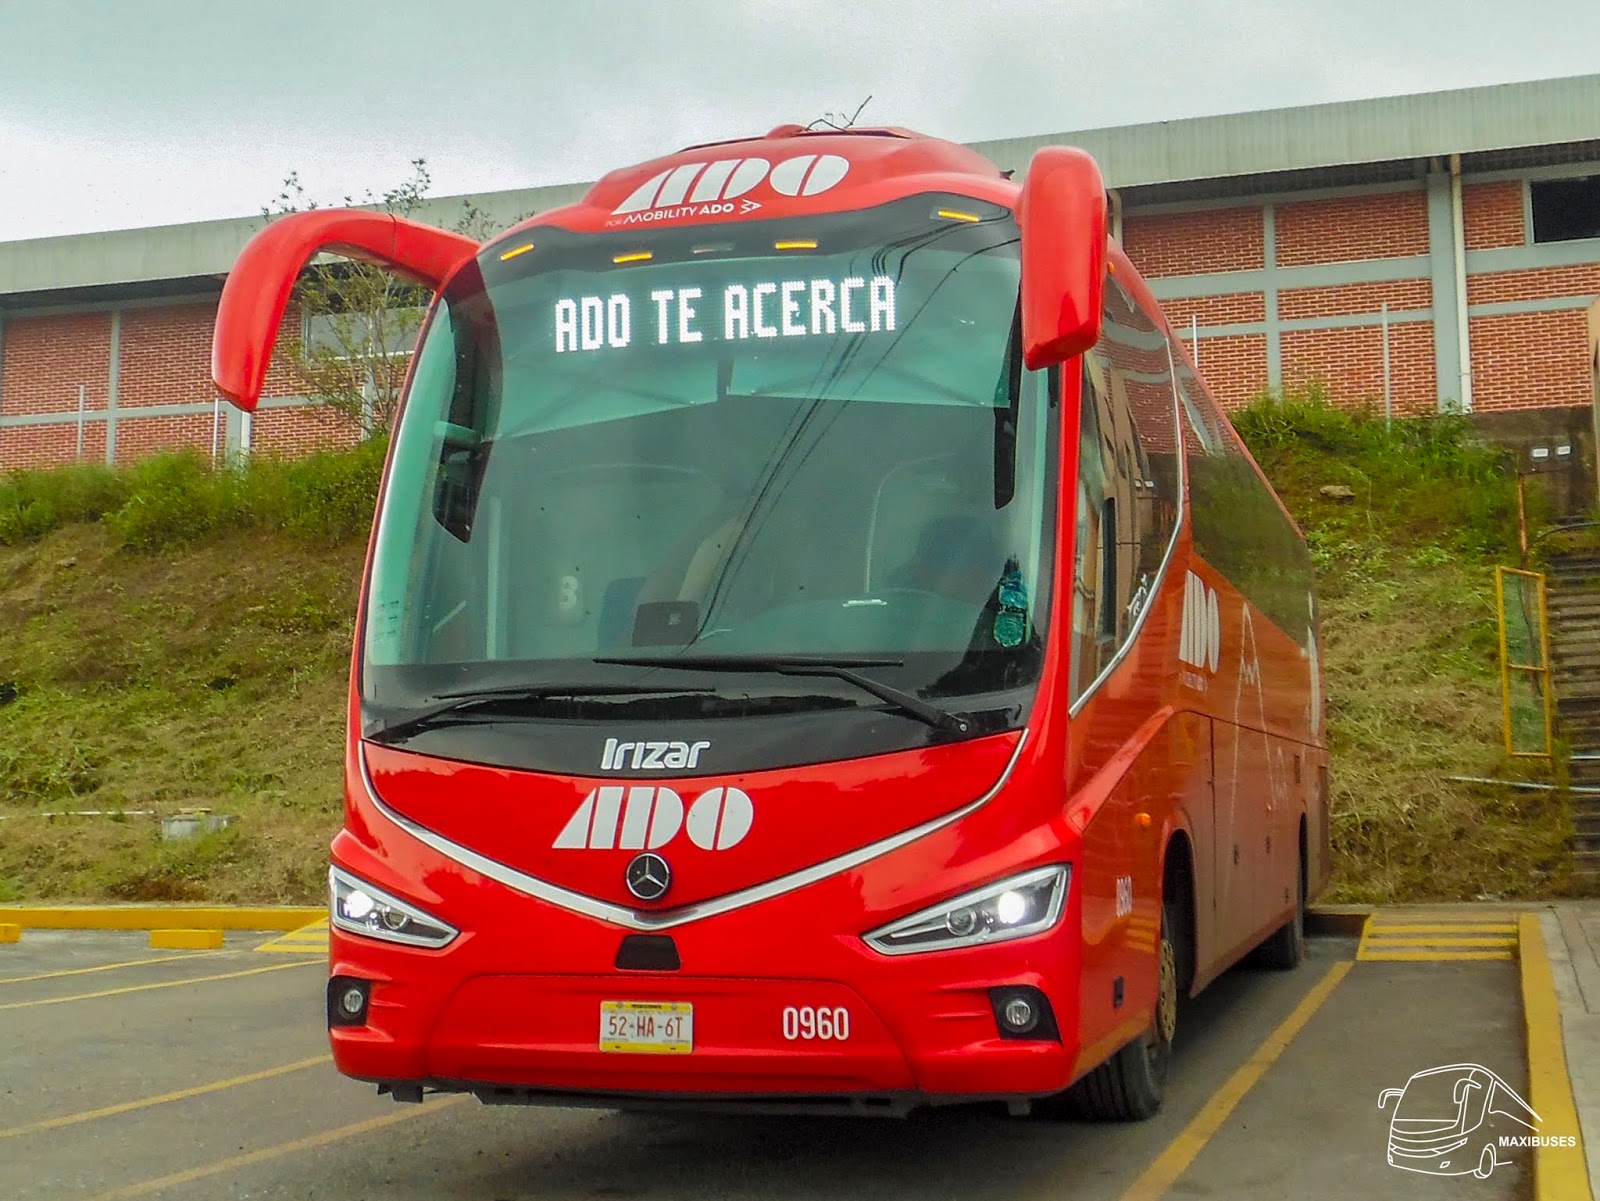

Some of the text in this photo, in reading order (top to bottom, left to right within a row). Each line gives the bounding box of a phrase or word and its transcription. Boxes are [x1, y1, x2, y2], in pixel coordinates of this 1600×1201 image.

[610, 154, 849, 214] ADO
[623, 206, 697, 225] MOBILITY
[700, 203, 734, 215] ADO
[555, 276, 896, 352] ADO TE ACERCA
[600, 738, 710, 770] Irizar
[551, 786, 754, 851] ADO
[783, 1006, 850, 1041] 0960
